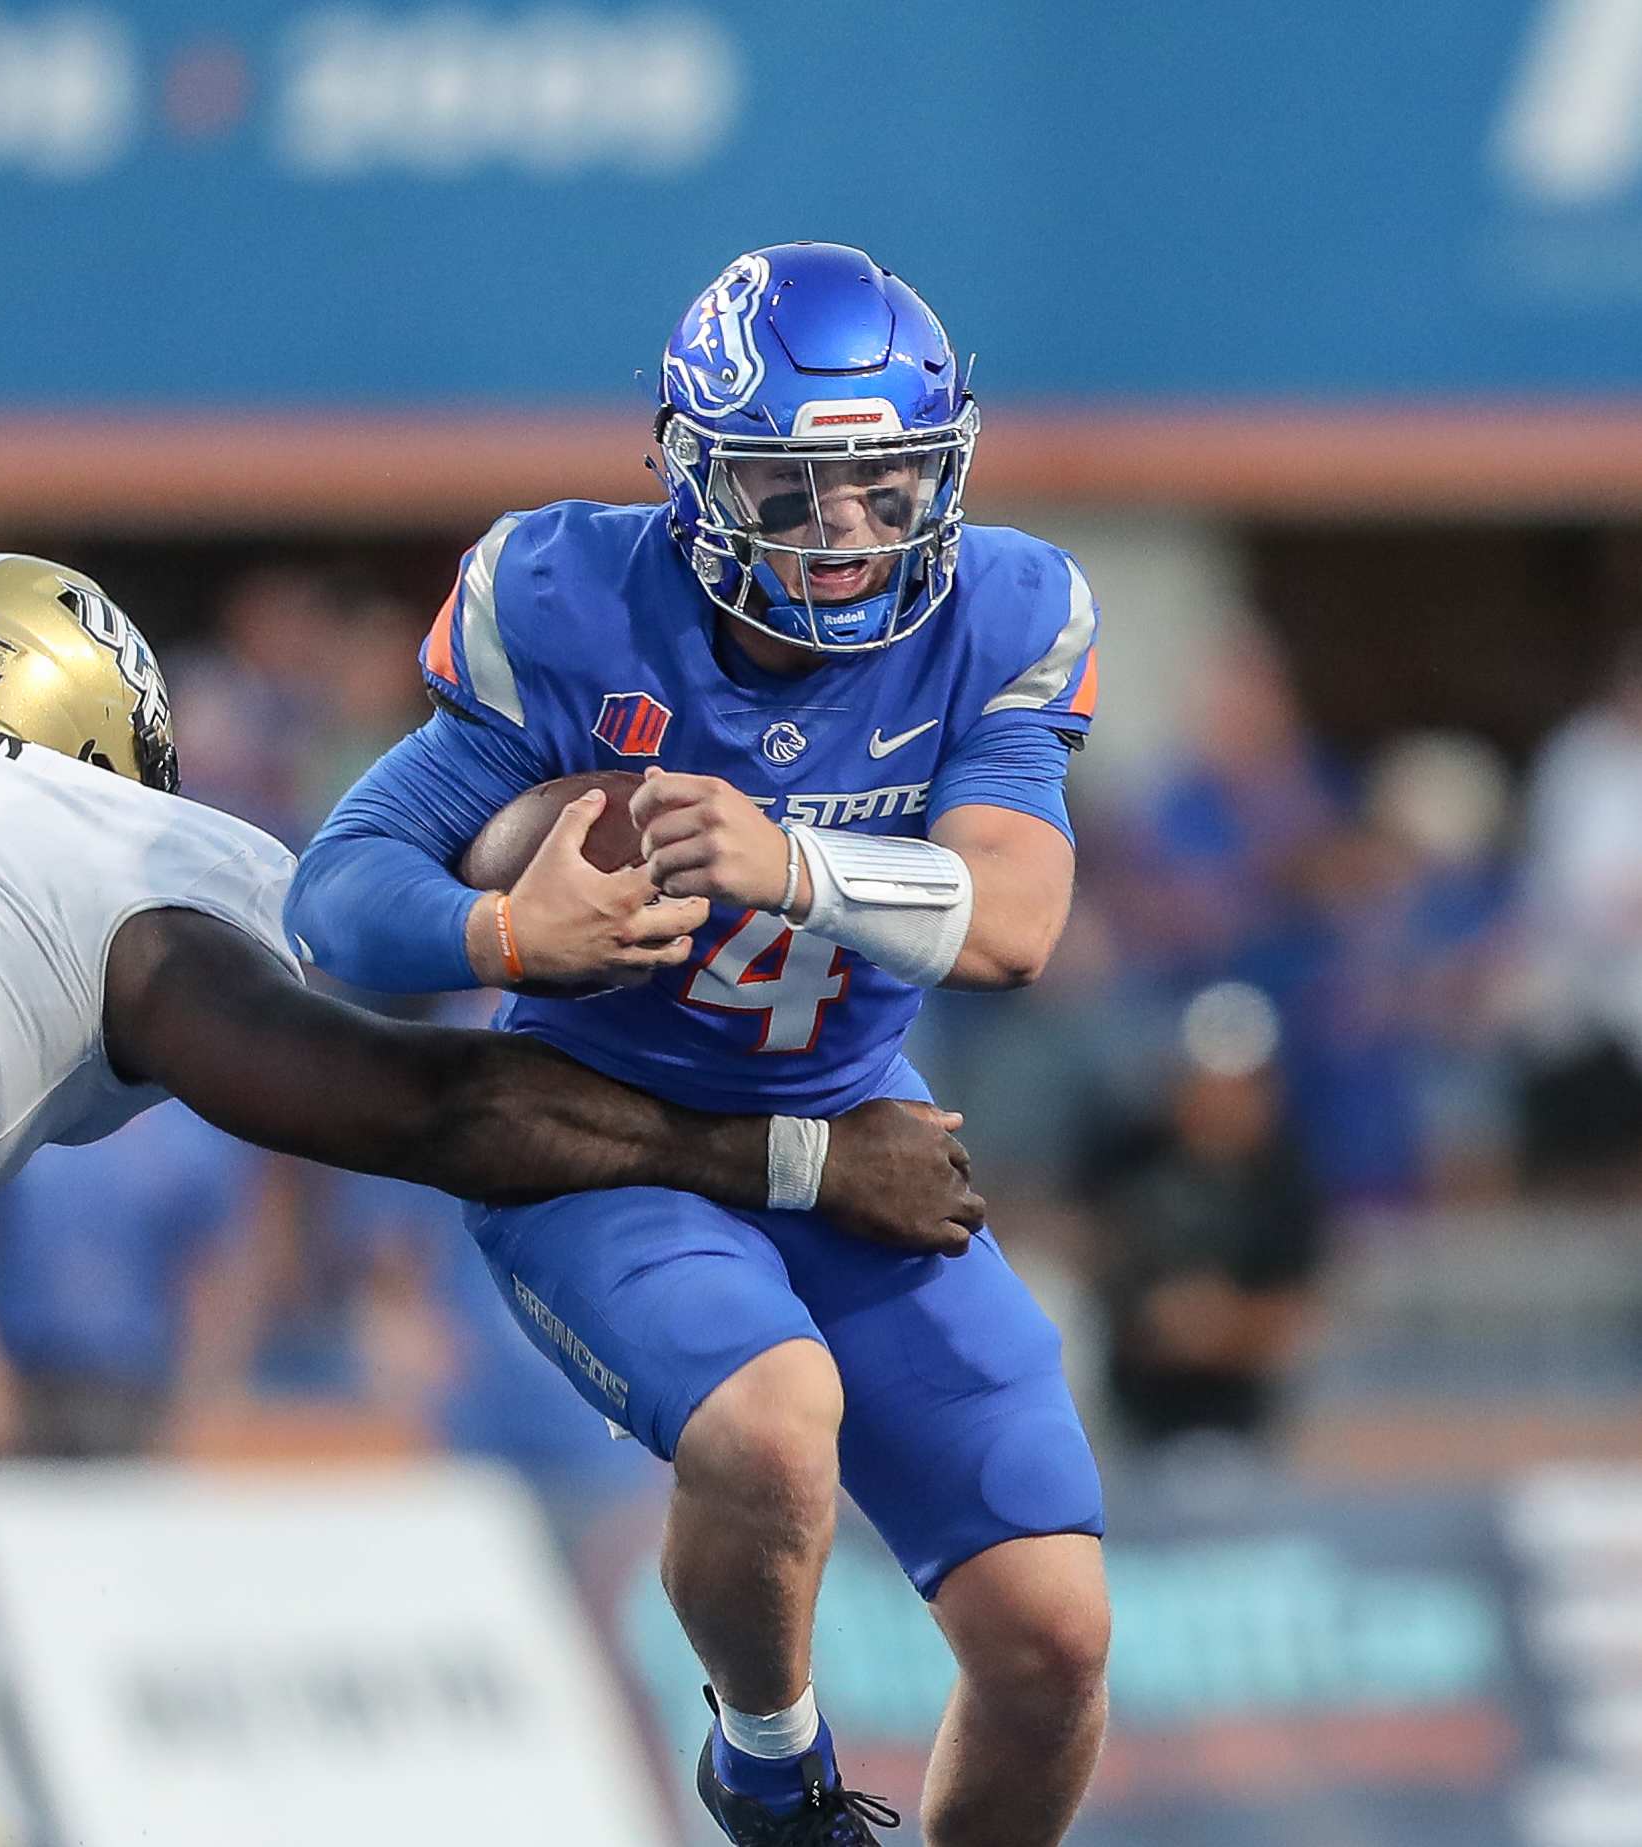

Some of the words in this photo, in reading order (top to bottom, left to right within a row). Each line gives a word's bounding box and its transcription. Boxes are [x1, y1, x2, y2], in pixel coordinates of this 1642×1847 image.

[823, 609, 866, 626] Riddell
[781, 780, 933, 827] STATE
[678, 904, 846, 1054] 4
